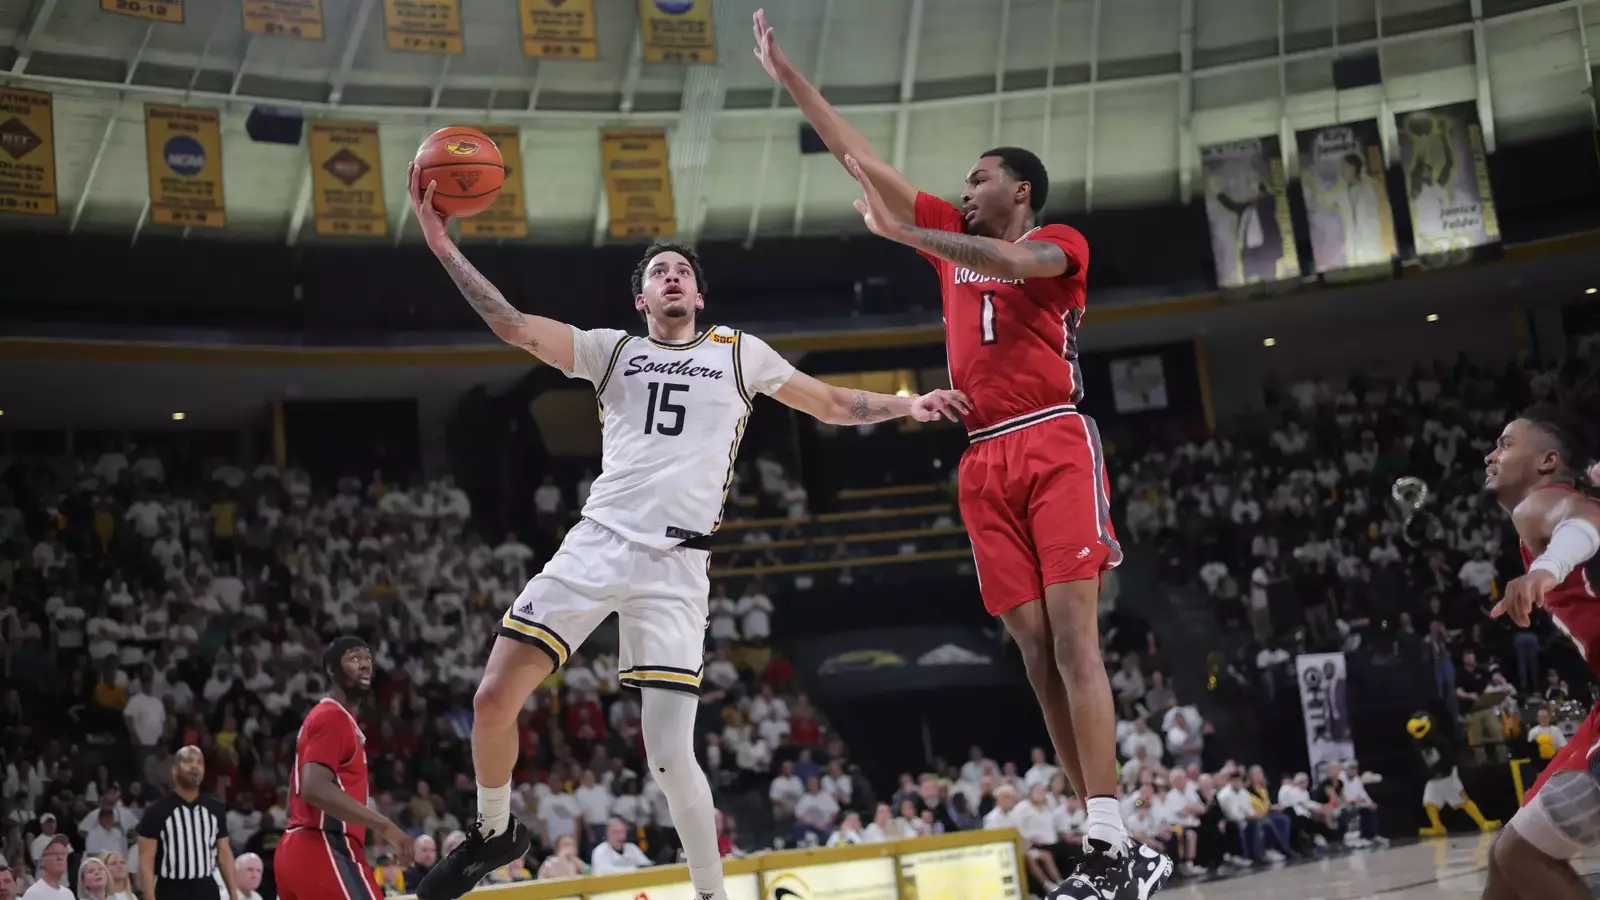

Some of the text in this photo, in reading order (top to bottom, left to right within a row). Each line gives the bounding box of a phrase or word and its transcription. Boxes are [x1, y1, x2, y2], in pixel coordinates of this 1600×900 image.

[981, 291, 997, 344] 1
[624, 355, 723, 380] Southern
[644, 382, 690, 436] 15
